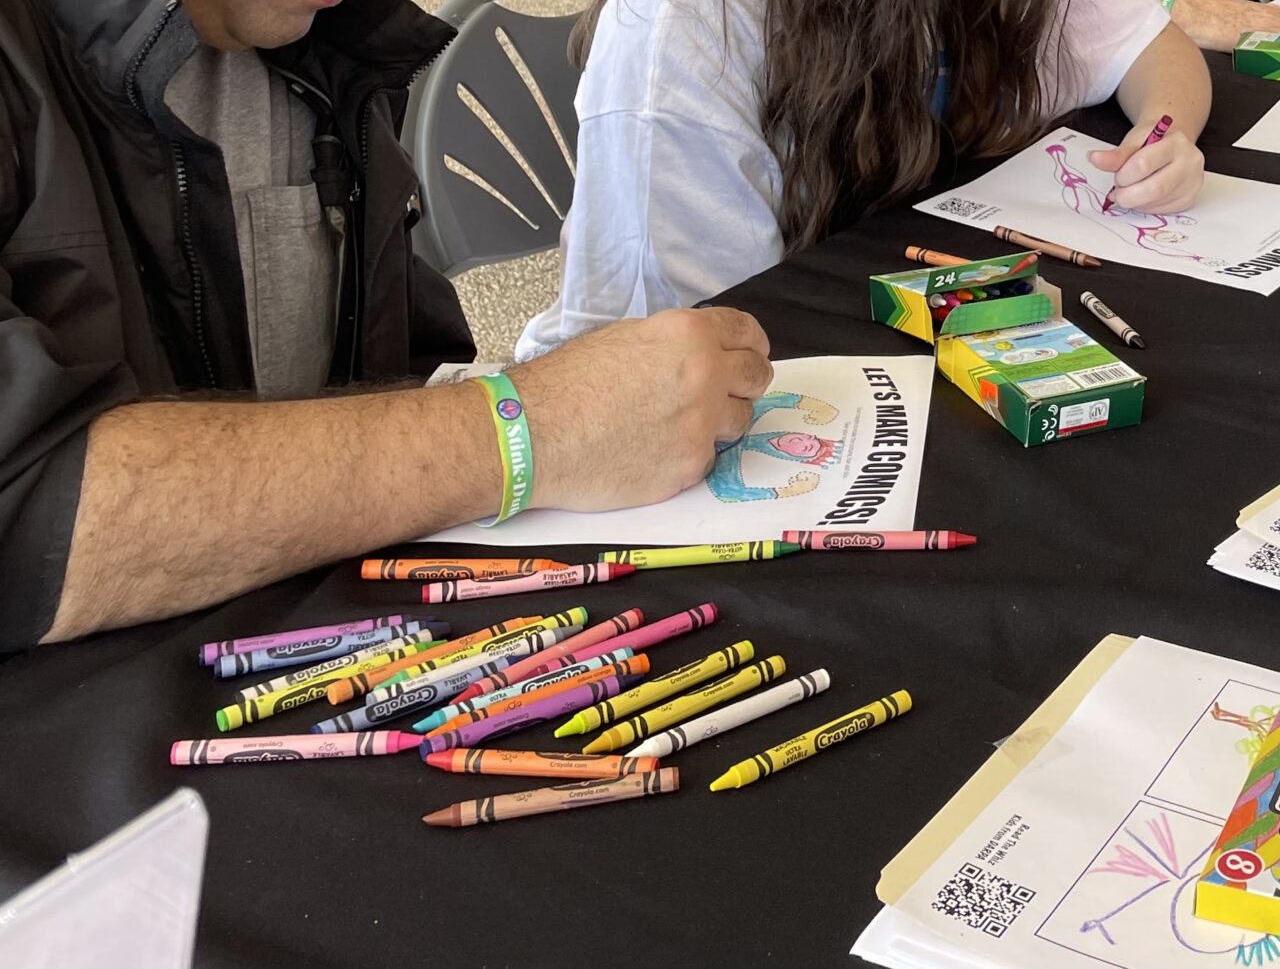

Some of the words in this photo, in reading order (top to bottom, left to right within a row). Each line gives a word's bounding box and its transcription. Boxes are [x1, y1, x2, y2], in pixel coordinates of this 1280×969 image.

[934, 272, 956, 288] 24
[861, 367, 902, 401] LET'S
[872, 404, 909, 448] MAKE
[816, 451, 907, 526] COMICS!
[830, 533, 883, 549] Crayola
[294, 654, 356, 682] Crayola
[375, 687, 435, 718] Crayola
[818, 717, 869, 749] Crayola
[782, 748, 809, 767] LAVABLE
[785, 745, 803, 757] ULTRA
[549, 762, 588, 770] Crayola.com
[569, 787, 610, 799] Crayola.com
[1005, 813, 1023, 829] Kids
[993, 826, 1012, 842] from
[1011, 823, 1030, 841] Read
[975, 839, 999, 861] DARPA
[1003, 836, 1017, 851] The
[1225, 854, 1256, 875] 8
